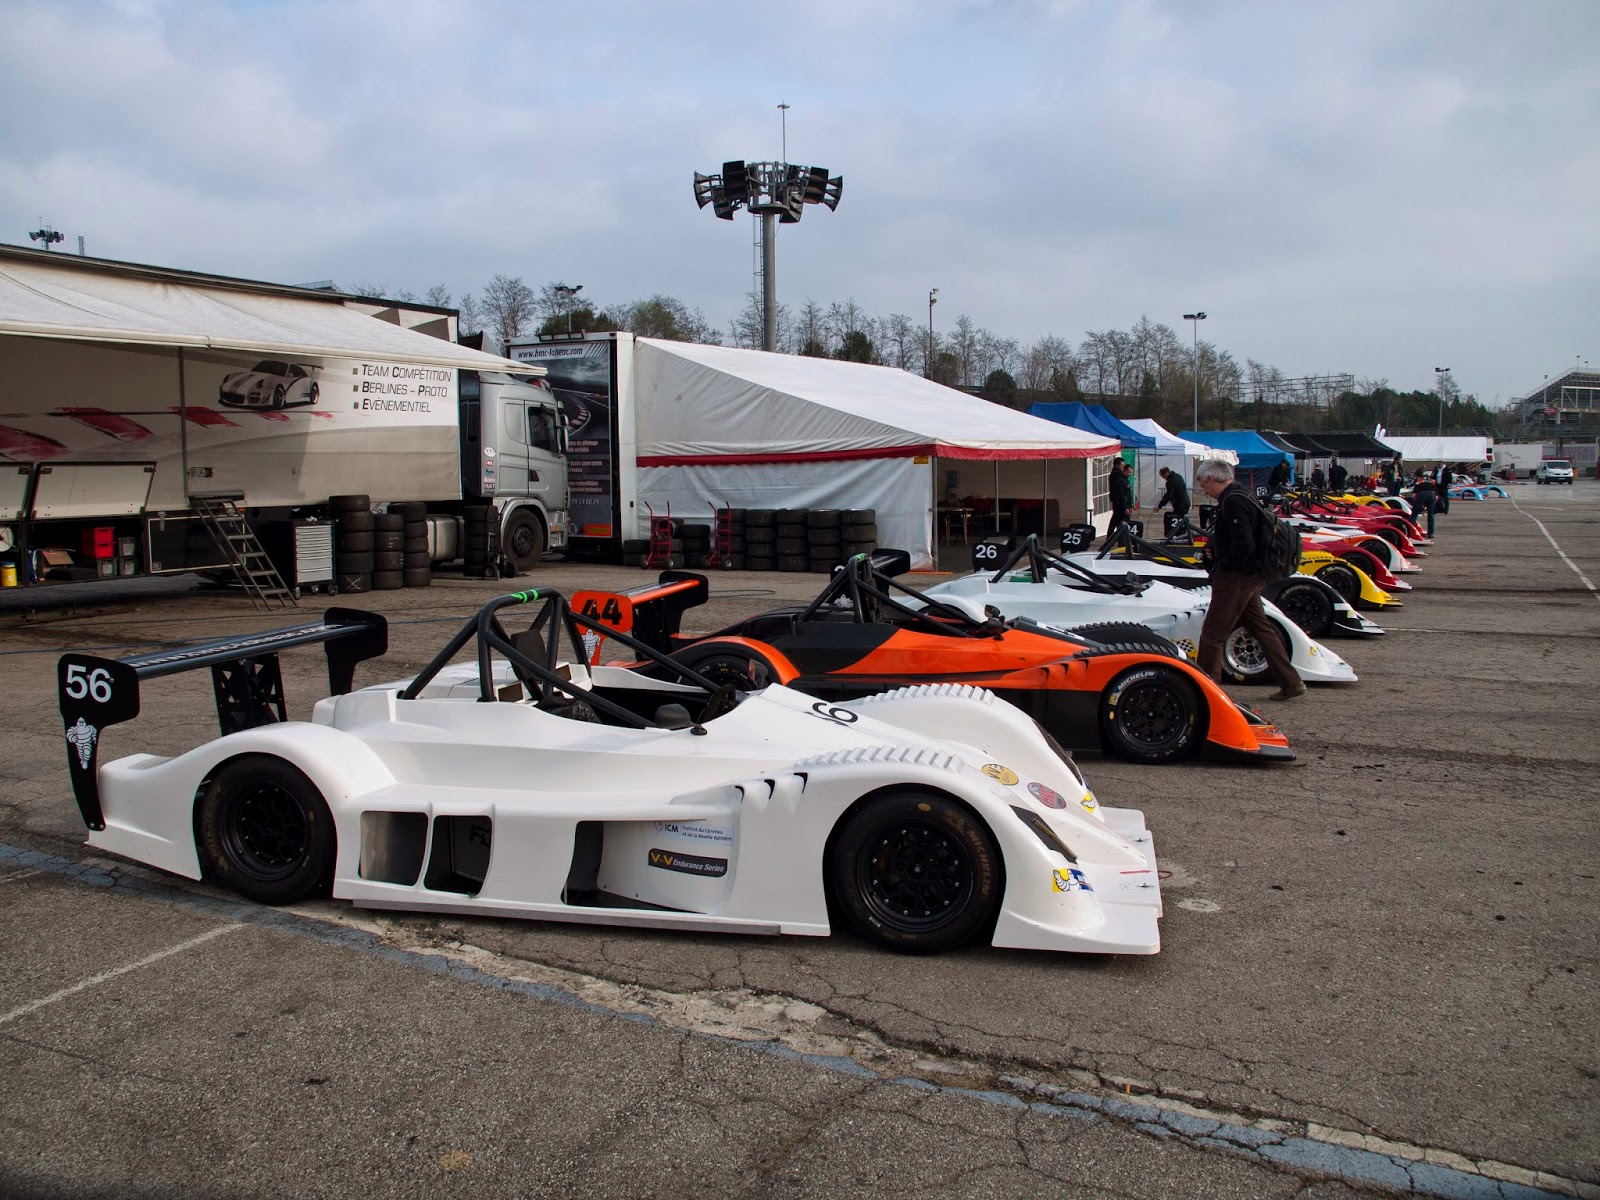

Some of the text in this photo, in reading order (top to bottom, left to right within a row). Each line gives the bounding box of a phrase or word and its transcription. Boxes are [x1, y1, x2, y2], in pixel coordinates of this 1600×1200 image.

[362, 364, 452, 382] TEAM COMPÉTITION
[362, 381, 408, 396] BERLINES
[418, 385, 448, 398] PROTO
[362, 397, 431, 413] EVÈNEMENTIEL
[1062, 532, 1082, 545] 25
[975, 544, 998, 559] 26
[580, 598, 622, 625] 44
[65, 664, 112, 703] 56
[1117, 671, 1156, 691] MICHELIN
[664, 824, 679, 833] ICM
[673, 859, 704, 871] Endurance
[704, 864, 725, 873] Series
